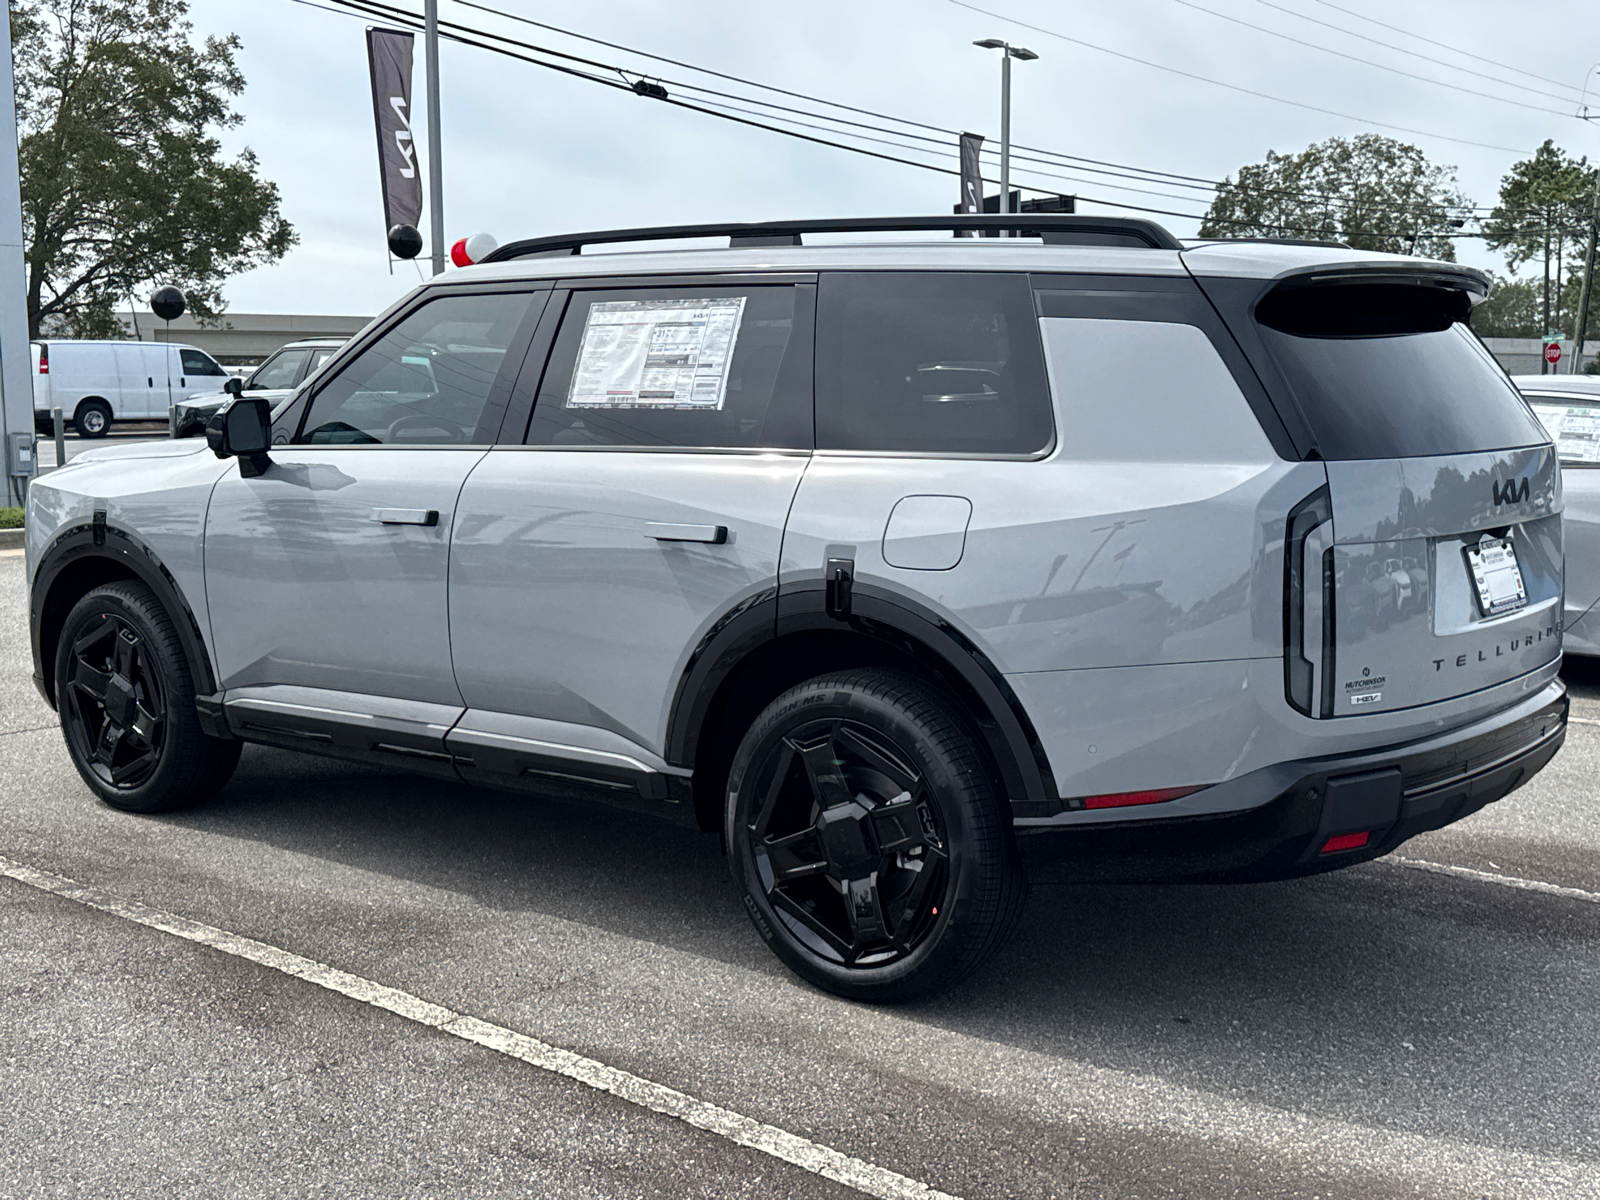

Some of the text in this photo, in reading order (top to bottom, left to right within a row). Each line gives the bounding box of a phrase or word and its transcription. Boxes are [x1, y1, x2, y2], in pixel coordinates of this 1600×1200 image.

[390, 96, 415, 178] KIA
[1547, 349, 1560, 358] STOP
[1492, 476, 1530, 506] KIA
[1432, 619, 1562, 672] TELLURIDE
[1345, 676, 1386, 689] HUTCHINSON
[802, 693, 826, 706] MS
[1356, 694, 1379, 703] HEV
